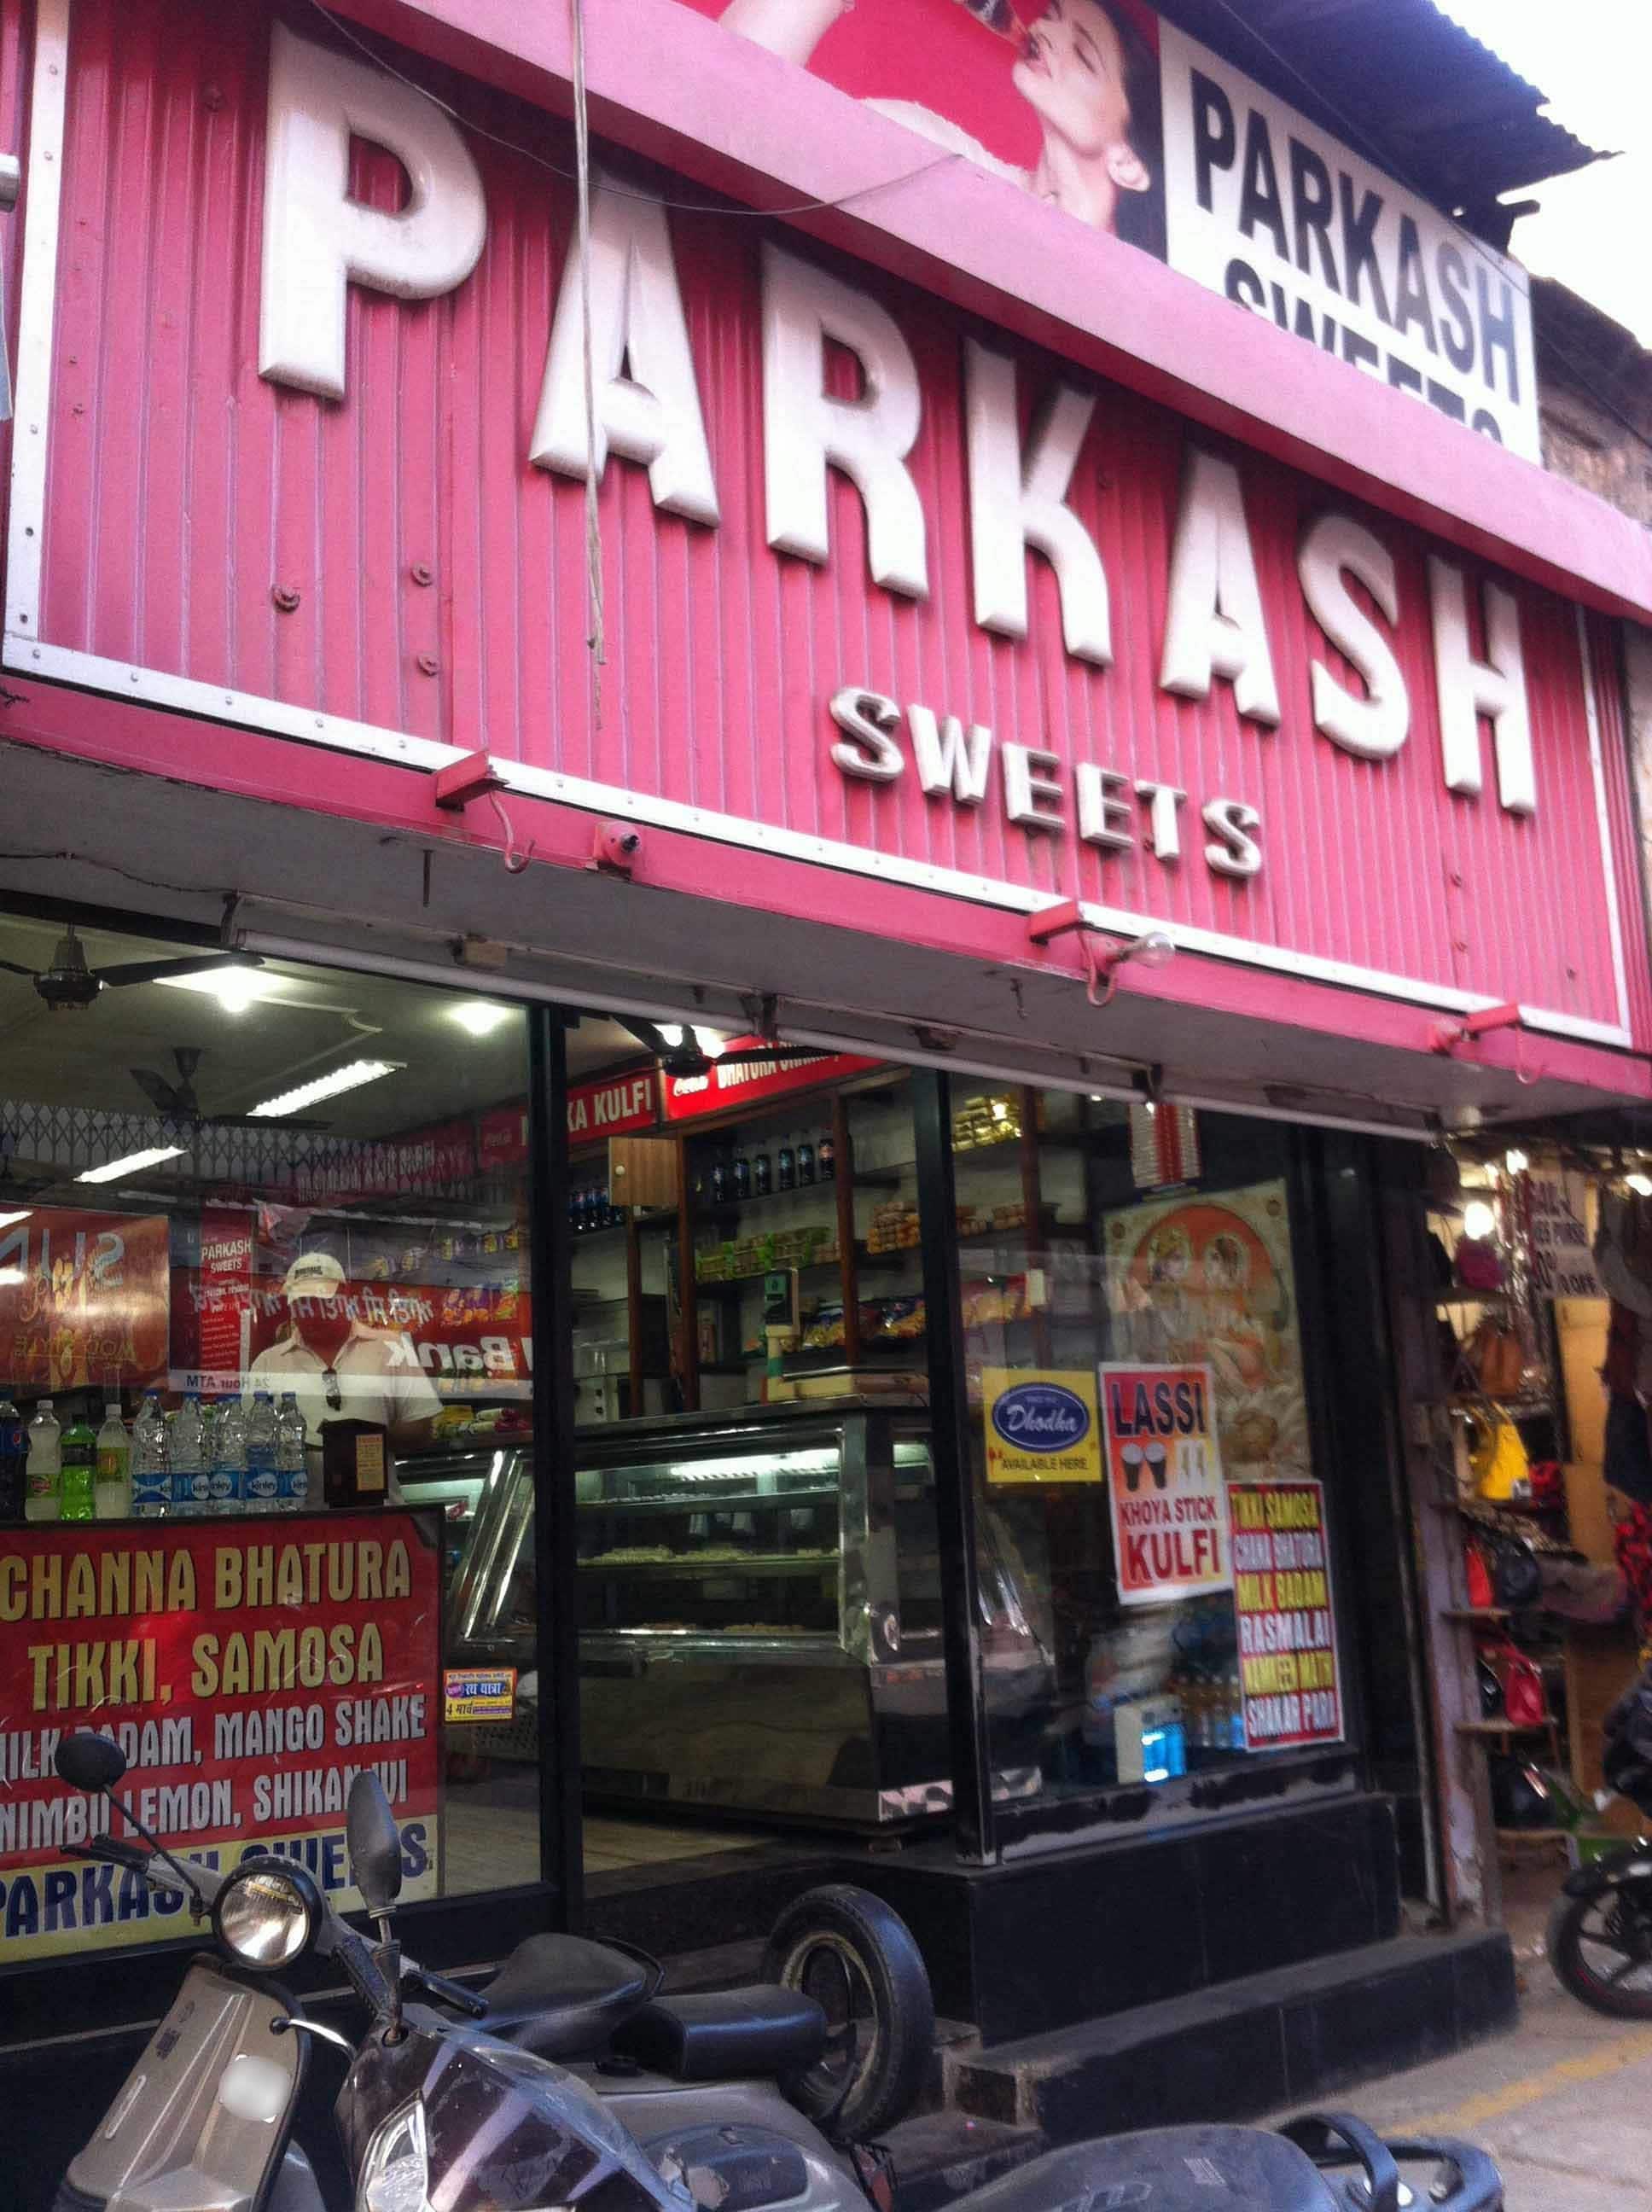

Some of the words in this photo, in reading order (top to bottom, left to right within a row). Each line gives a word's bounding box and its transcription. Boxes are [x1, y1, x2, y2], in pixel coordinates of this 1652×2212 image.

[1190, 67, 1520, 406] PARKASH
[259, 19, 1536, 816] PARKASH
[830, 686, 1262, 877] SWEETS
[594, 1079, 651, 1126] KULFI
[201, 1239, 252, 1260] PARKASH
[211, 1258, 242, 1274] SWEETS
[1111, 1382, 1207, 1437] LASSI
[1002, 1458, 1056, 1471] AVAILABLE
[1059, 1457, 1088, 1470] HERE
[1120, 1499, 1171, 1526] KHOYA
[1174, 1496, 1217, 1523] STICK
[0, 1549, 196, 1622] CHANNA
[216, 1540, 410, 1610] BHATURA
[1126, 1528, 1221, 1580] KULFI
[1240, 1611, 1332, 1653] RASMALAI
[27, 1639, 172, 1711] TIKKI,
[191, 1622, 383, 1697] SAMOSA
[215, 1703, 323, 1761] MANGO
[335, 1694, 427, 1748] SHAKE
[0, 1793, 110, 1852] NIMBU
